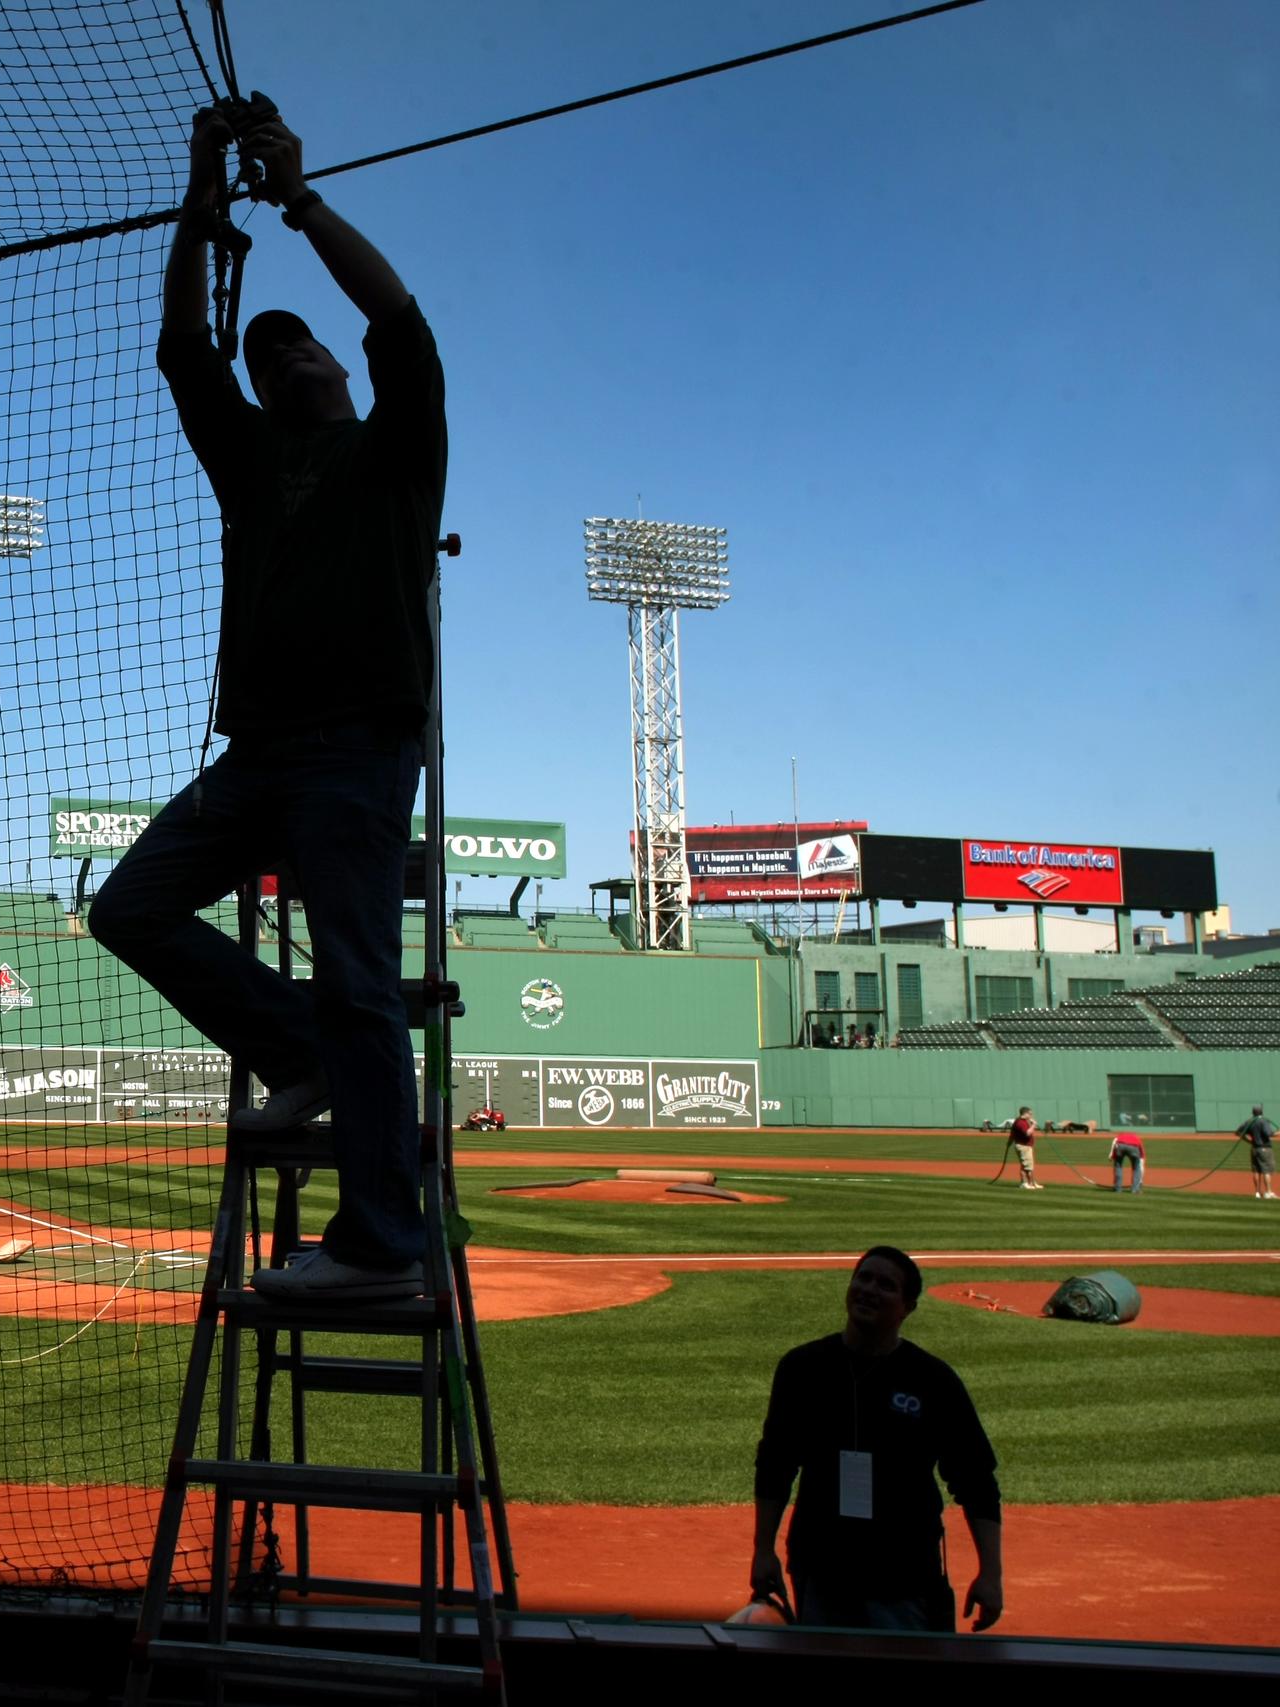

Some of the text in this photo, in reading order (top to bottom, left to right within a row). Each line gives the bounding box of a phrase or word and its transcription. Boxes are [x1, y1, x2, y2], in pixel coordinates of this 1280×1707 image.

[55, 811, 151, 835] SPORTS
[55, 833, 140, 847] AUTHORIT
[711, 853, 744, 864] happens
[746, 852, 754, 861] in
[970, 843, 1116, 869] Bank of America
[707, 864, 740, 875] happens
[742, 864, 750, 873] in
[466, 1061, 498, 1069] LEAGUE
[585, 1068, 645, 1086] WEBB
[656, 1071, 751, 1105] GRANITE CITY
[46, 1095, 71, 1104] SINCE
[548, 1097, 573, 1109] Since
[620, 1098, 645, 1110] 1866
[761, 1100, 781, 1110] 379
[684, 1116, 708, 1124] SINCE
